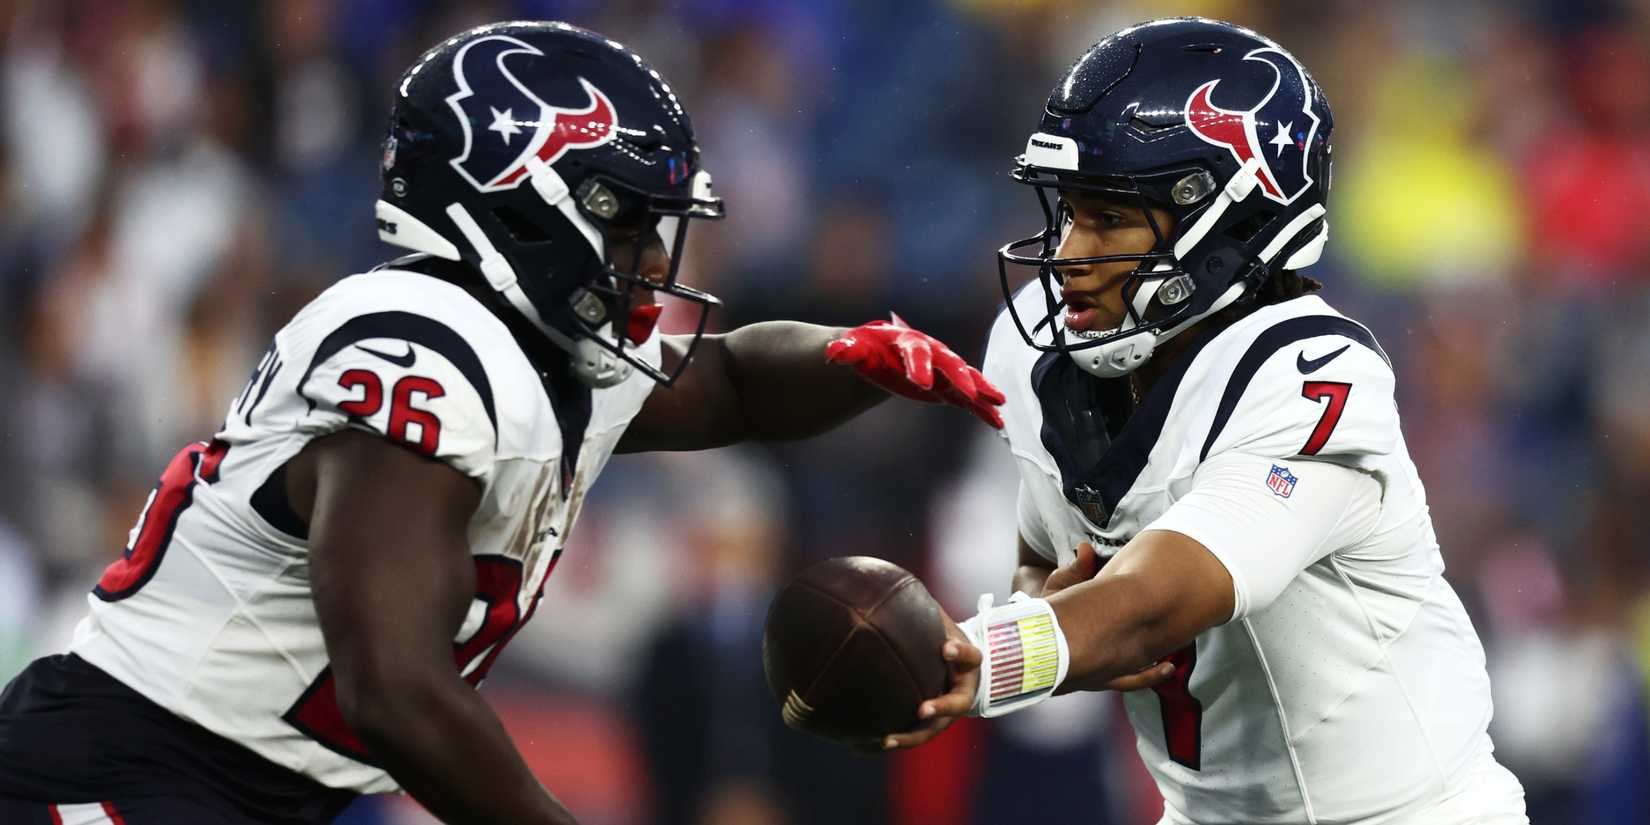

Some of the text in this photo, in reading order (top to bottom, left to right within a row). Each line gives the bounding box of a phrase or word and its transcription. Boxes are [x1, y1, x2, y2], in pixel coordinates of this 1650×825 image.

[336, 368, 446, 457] 26
[1297, 381, 1352, 456] 7
[1269, 474, 1290, 497] NFL
